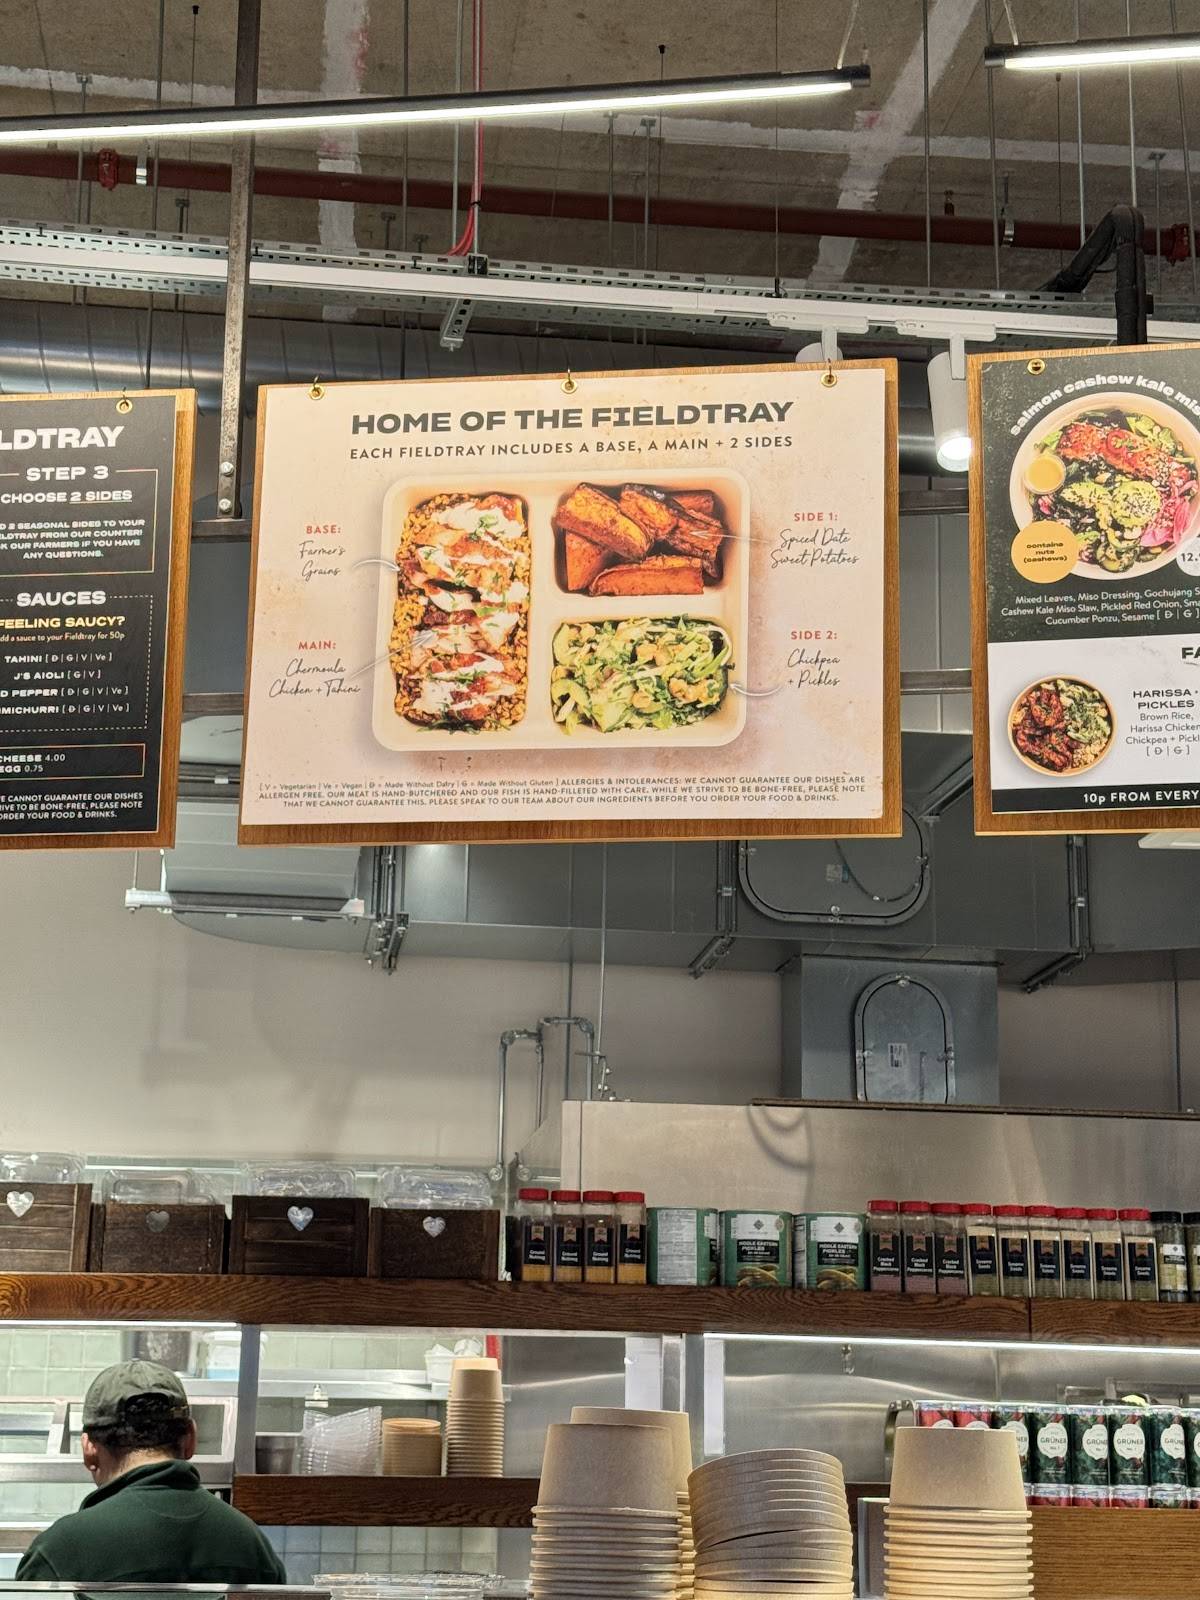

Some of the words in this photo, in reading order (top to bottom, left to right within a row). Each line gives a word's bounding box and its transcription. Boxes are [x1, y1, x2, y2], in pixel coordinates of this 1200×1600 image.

[1010, 388, 1063, 436] salmon
[1063, 374, 1134, 394] cashew
[1135, 374, 1175, 396] kale
[352, 413, 451, 434] HOME
[460, 411, 506, 431] OF
[514, 408, 583, 429] THE
[592, 402, 794, 427] FIELDTRAY
[350, 448, 393, 459] EACH
[400, 445, 485, 458] FIELDTRAY
[492, 443, 573, 456] INCLUDES
[579, 443, 589, 452] A
[596, 440, 642, 453] BASE,
[648, 440, 658, 450] A
[665, 438, 708, 450] MAIN
[730, 438, 738, 448] 2
[745, 436, 793, 447] SIDES
[26, 467, 86, 481] STEP
[93, 466, 108, 480] 3
[2, 492, 67, 504] CHOOSE
[70, 492, 81, 501] 2
[86, 490, 132, 501] SIDES
[794, 512, 823, 521] SIDE
[829, 512, 838, 521] 1:
[72, 520, 101, 528] SIDES
[306, 525, 341, 534] BASE:
[93, 529, 143, 537] COUNTER!
[780, 528, 818, 550] Spiced
[821, 527, 852, 547] Date
[33, 540, 80, 548] FARMERS
[299, 540, 346, 559] Farmer's
[45, 550, 104, 559] QUESTIONS.
[771, 549, 811, 569] Sweet
[810, 548, 859, 567] Potatoes
[302, 560, 341, 582] Grains
[17, 591, 106, 607] SAUCES
[1015, 596, 1042, 604] Mixed
[1044, 594, 1076, 603] Leaves,
[1078, 593, 1099, 601] Miso
[1101, 591, 1142, 601] Dressing,
[1144, 588, 1192, 600] Gochujang
[1001, 607, 1033, 616] Cashew
[1036, 606, 1053, 614] Kale
[1056, 605, 1076, 613] Miso
[1078, 604, 1099, 613] Slaw,
[1101, 602, 1132, 611] Pickled
[1134, 601, 1151, 609] Red
[1153, 599, 1182, 609] Onion,
[0, 618, 61, 629] FEELING
[65, 616, 125, 627] SAUCY?
[1045, 617, 1089, 625] Cucumber
[1092, 614, 1120, 624] Ponzu,
[1122, 612, 1154, 621] Sesame
[46, 634, 63, 642] your
[65, 633, 97, 642] Fieldtray
[109, 631, 125, 641] 50p
[791, 631, 821, 640] SIDE
[826, 631, 837, 640] 2:
[298, 641, 336, 650] MAIN:
[5, 655, 42, 663] TAHINI
[787, 648, 840, 670] Chickpea
[286, 657, 346, 677] Chermoula
[14, 672, 30, 680] J'S
[798, 670, 840, 688] Pickles
[12, 689, 58, 697] PEPPER
[269, 679, 313, 698] Chicken
[325, 678, 361, 697] Tahini
[1133, 688, 1191, 699] HARISSA
[1138, 700, 1195, 710] PICKLES
[1140, 713, 1168, 721] Brown
[1172, 712, 1194, 722] Rice,
[1130, 724, 1162, 733] Harissa
[1126, 736, 1167, 746] Chickpea
[45, 754, 66, 762] 4.00
[382, 789, 457, 797] HAND-BUTCHERED
[1083, 793, 1106, 805] 10p
[1111, 792, 1150, 802] FROM
[1155, 790, 1199, 801] EVERY
[41, 802, 88, 810] BONE-FREE,
